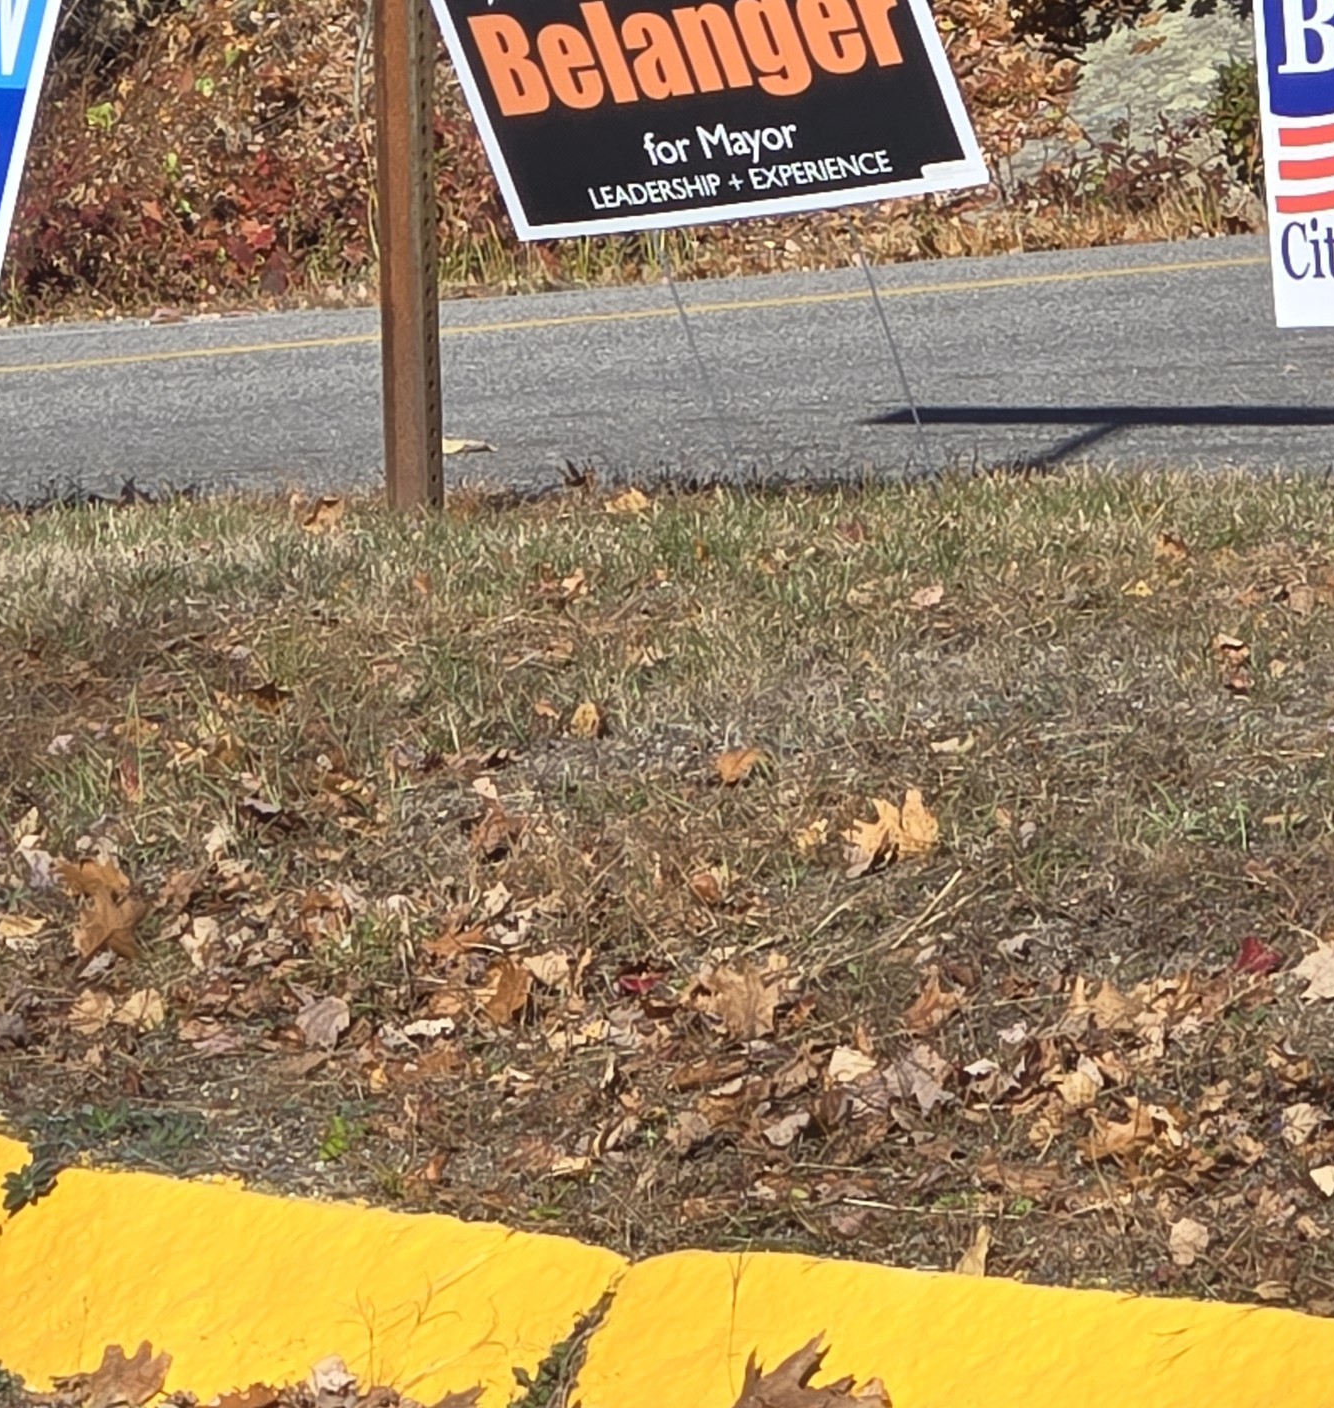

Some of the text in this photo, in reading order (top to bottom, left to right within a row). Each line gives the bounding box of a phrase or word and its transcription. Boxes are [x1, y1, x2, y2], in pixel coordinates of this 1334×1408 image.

[642, 121, 797, 167] for Mayor
[588, 174, 721, 211] LEADERSHIP
[747, 150, 893, 191] EXPERIENCE
